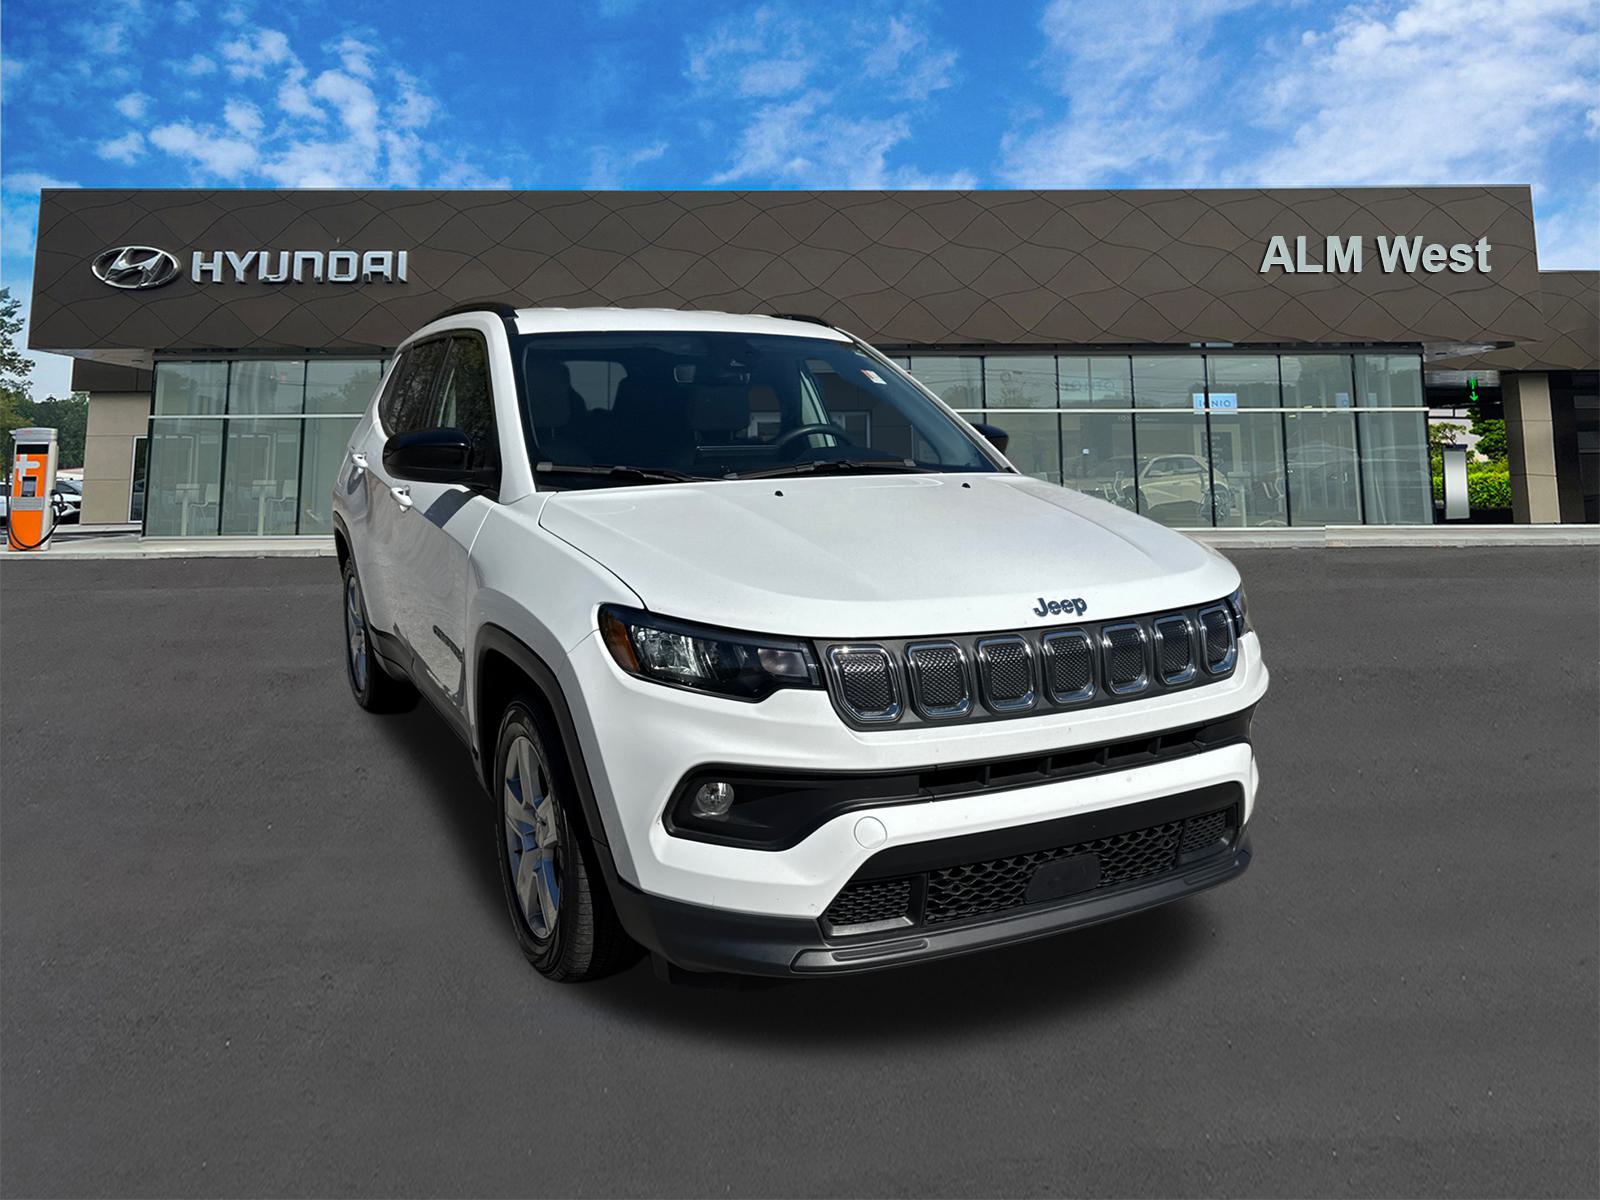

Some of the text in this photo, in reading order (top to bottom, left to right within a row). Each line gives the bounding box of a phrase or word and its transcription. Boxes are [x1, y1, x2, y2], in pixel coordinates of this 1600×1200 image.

[192, 251, 408, 283] HYUNDAI
[1260, 236, 1492, 272] ALM West
[1033, 597, 1087, 617] Jeep
